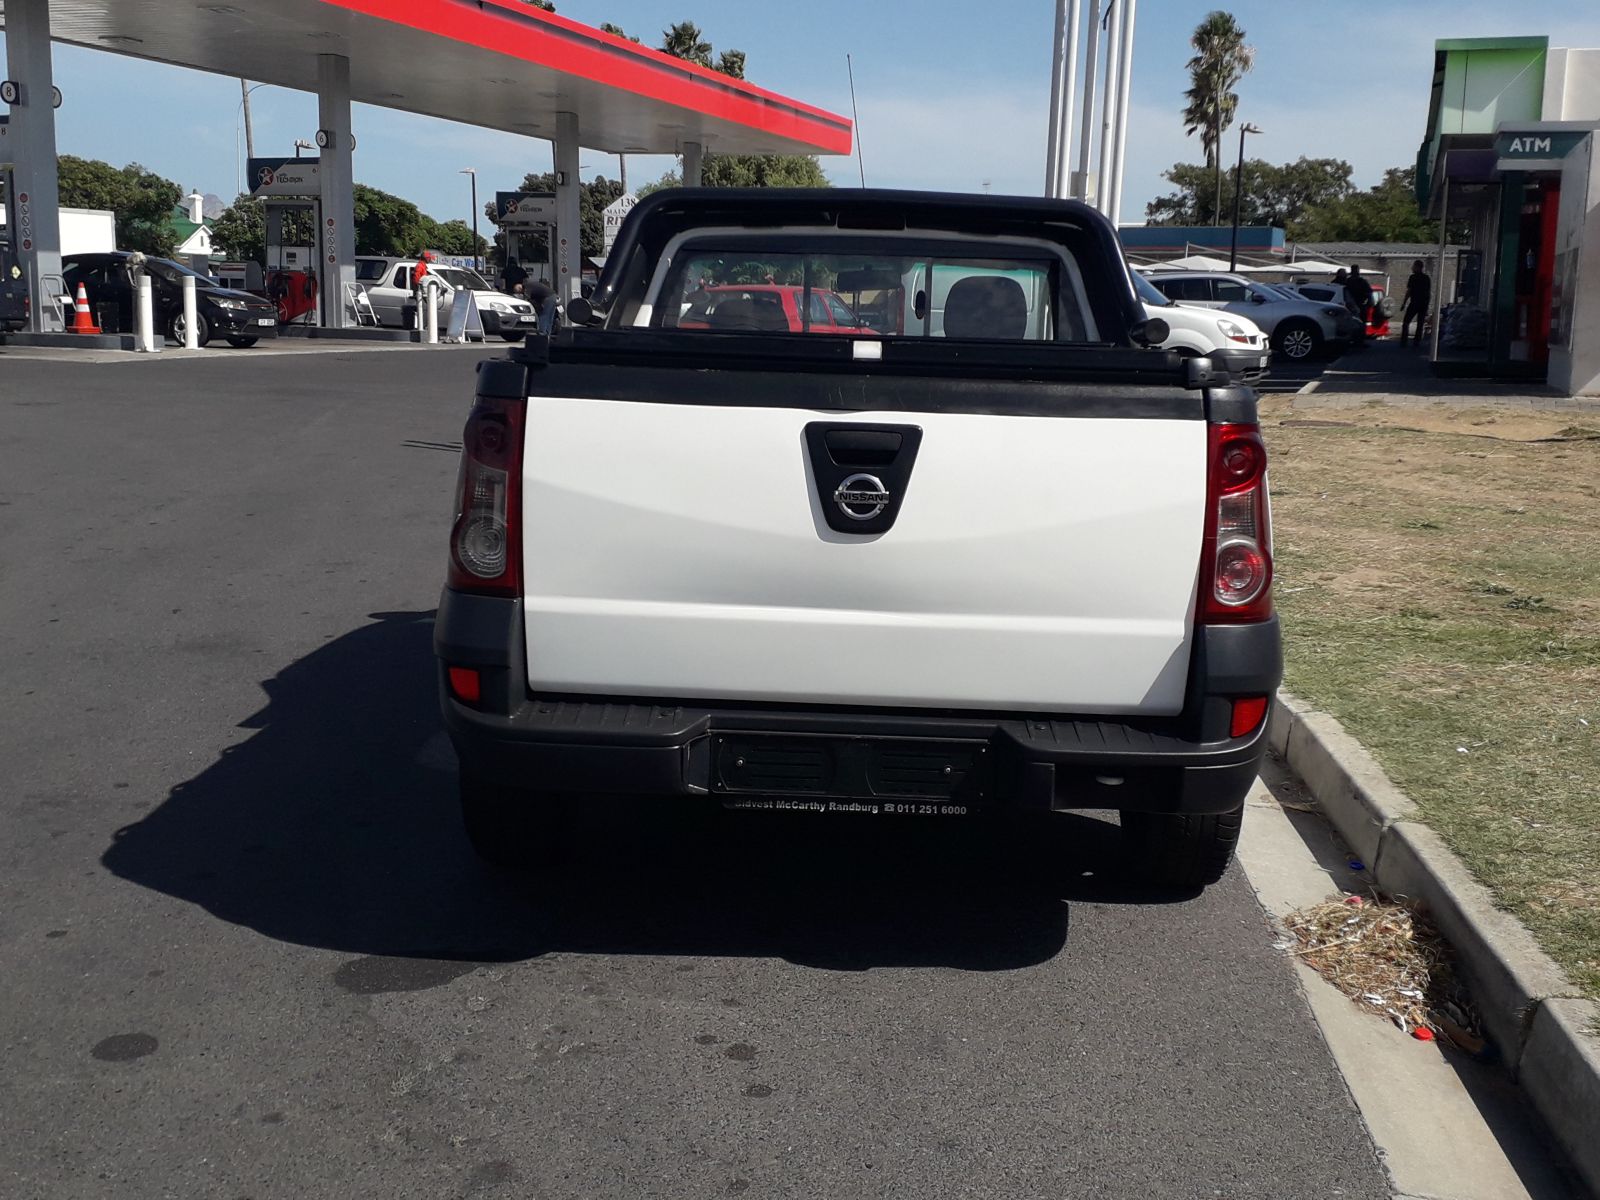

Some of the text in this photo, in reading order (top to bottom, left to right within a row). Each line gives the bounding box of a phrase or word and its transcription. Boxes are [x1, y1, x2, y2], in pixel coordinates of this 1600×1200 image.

[1509, 137, 1551, 152] ATM
[451, 257, 463, 267] Car
[839, 493, 884, 502] NISSAN
[776, 800, 826, 812] McCarthy
[829, 801, 879, 814] Randburg
[897, 804, 916, 813] 011
[919, 804, 938, 814] 251
[941, 806, 967, 815] 6000
